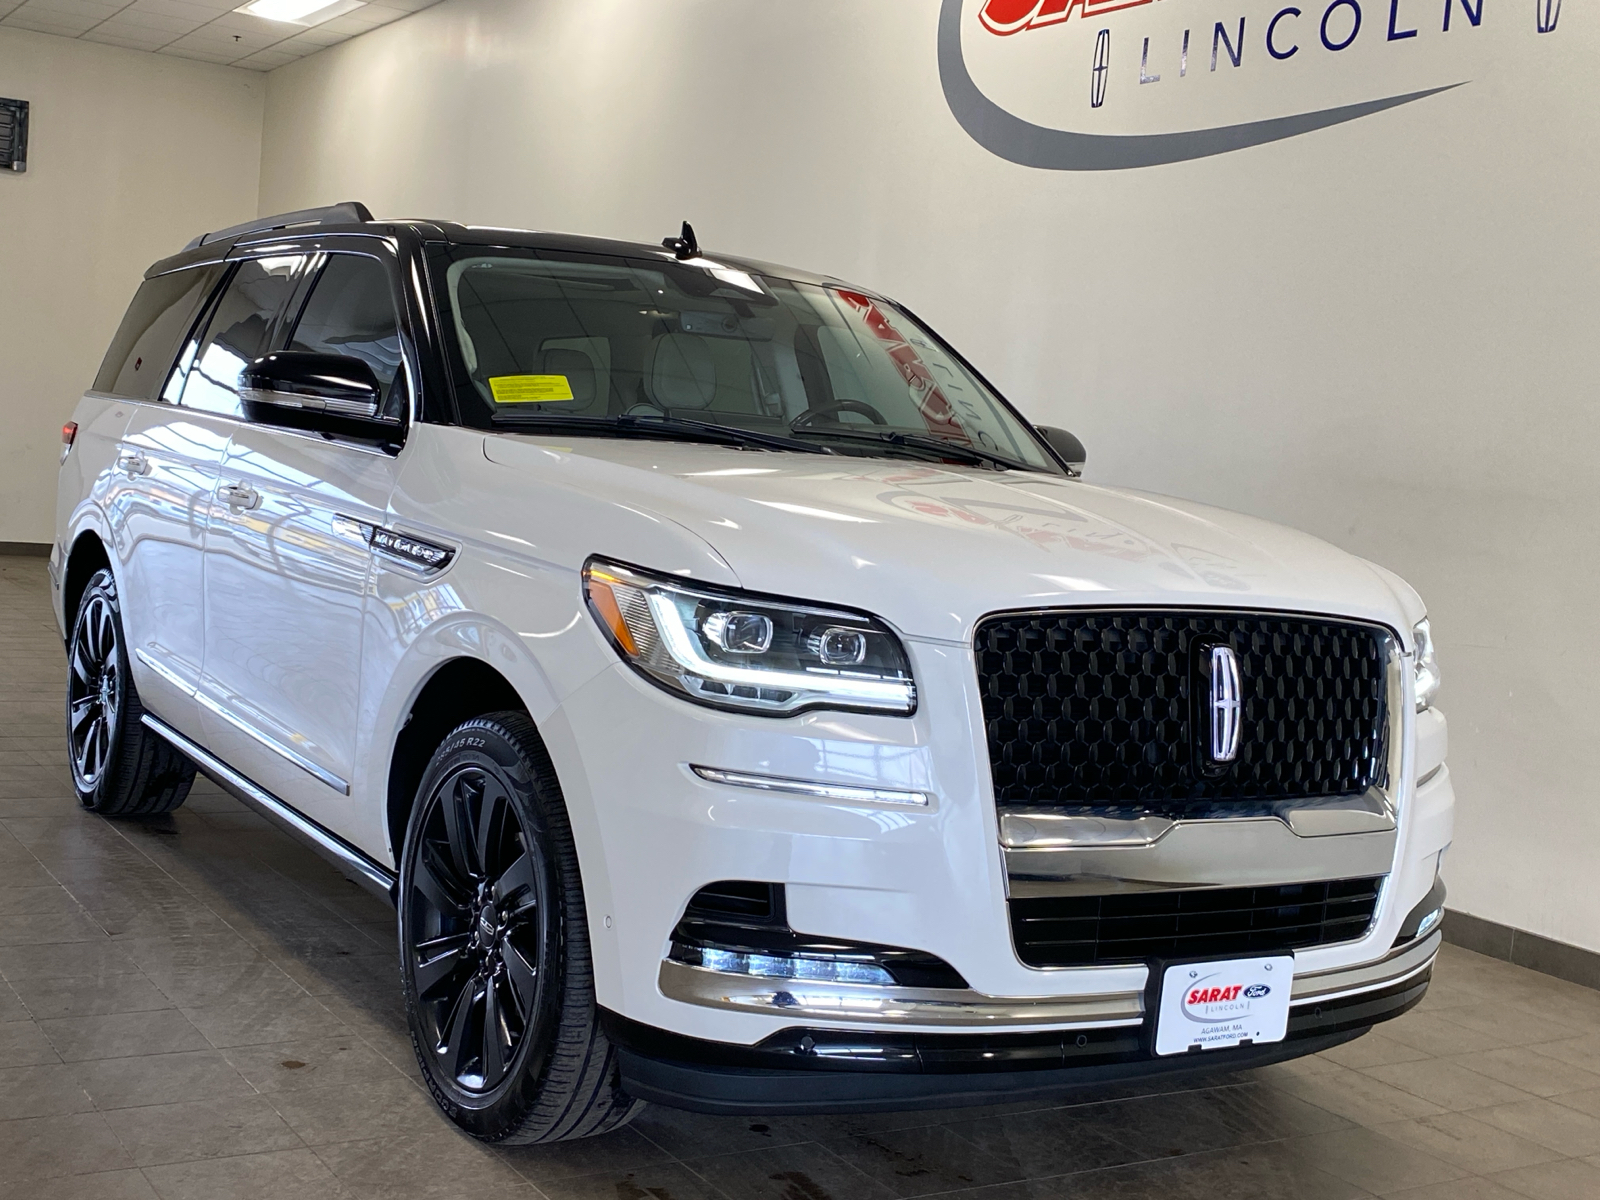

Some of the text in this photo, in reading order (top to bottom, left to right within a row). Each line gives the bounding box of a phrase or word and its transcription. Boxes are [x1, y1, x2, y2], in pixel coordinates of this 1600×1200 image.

[1140, 0, 1484, 84] LINCOLN
[466, 737, 486, 748] R22
[1187, 984, 1269, 1005] SARAT Ford
[1211, 1003, 1245, 1012] LINCOLN
[1201, 1025, 1231, 1035] AGAWAM,
[1193, 1032, 1249, 1043] WWW.SARATFORD.COM
